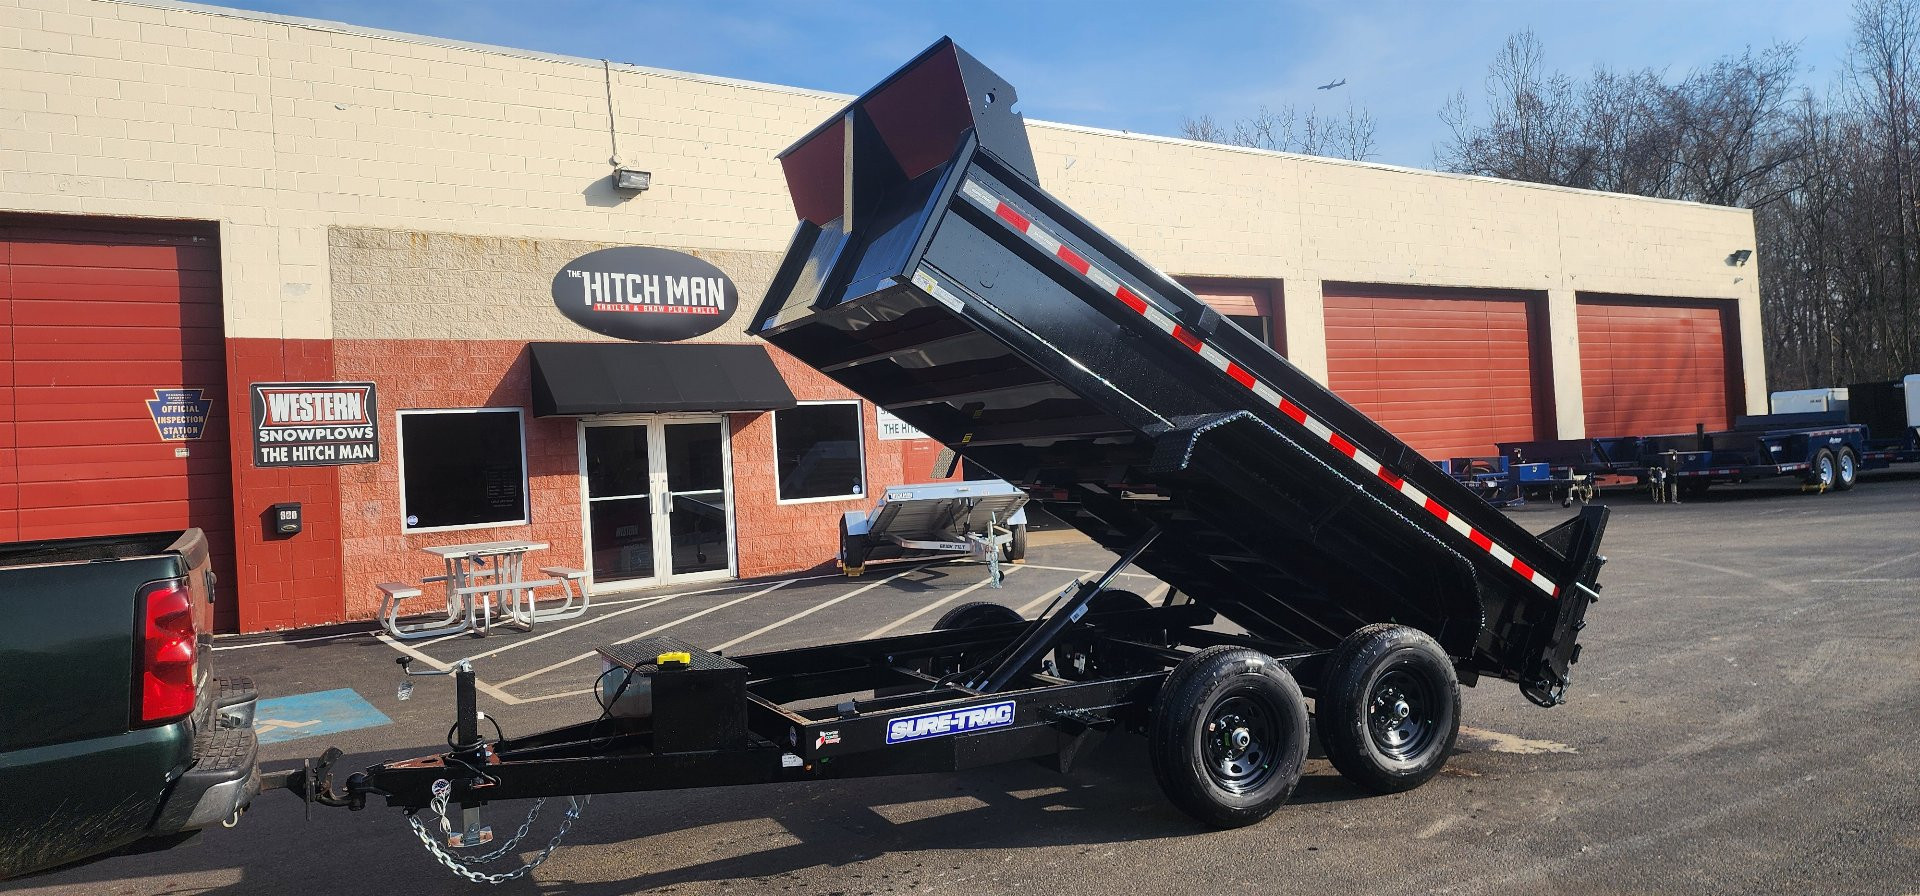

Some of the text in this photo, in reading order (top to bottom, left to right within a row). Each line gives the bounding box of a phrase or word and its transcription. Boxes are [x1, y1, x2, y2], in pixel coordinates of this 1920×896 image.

[567, 269, 725, 311] THE HITCH MAN
[597, 303, 630, 311] TRAILER
[668, 305, 689, 313] PLOW
[161, 405, 200, 413] OFFICIAL
[268, 392, 362, 422] WESTERN
[157, 416, 204, 424] INSPECTION
[163, 426, 198, 435] STATION
[259, 427, 374, 442] SNOWPLOWS
[884, 423, 900, 434] THE
[261, 443, 374, 463] THE HITCH MAN
[890, 705, 1012, 740] SURE-TRAC
